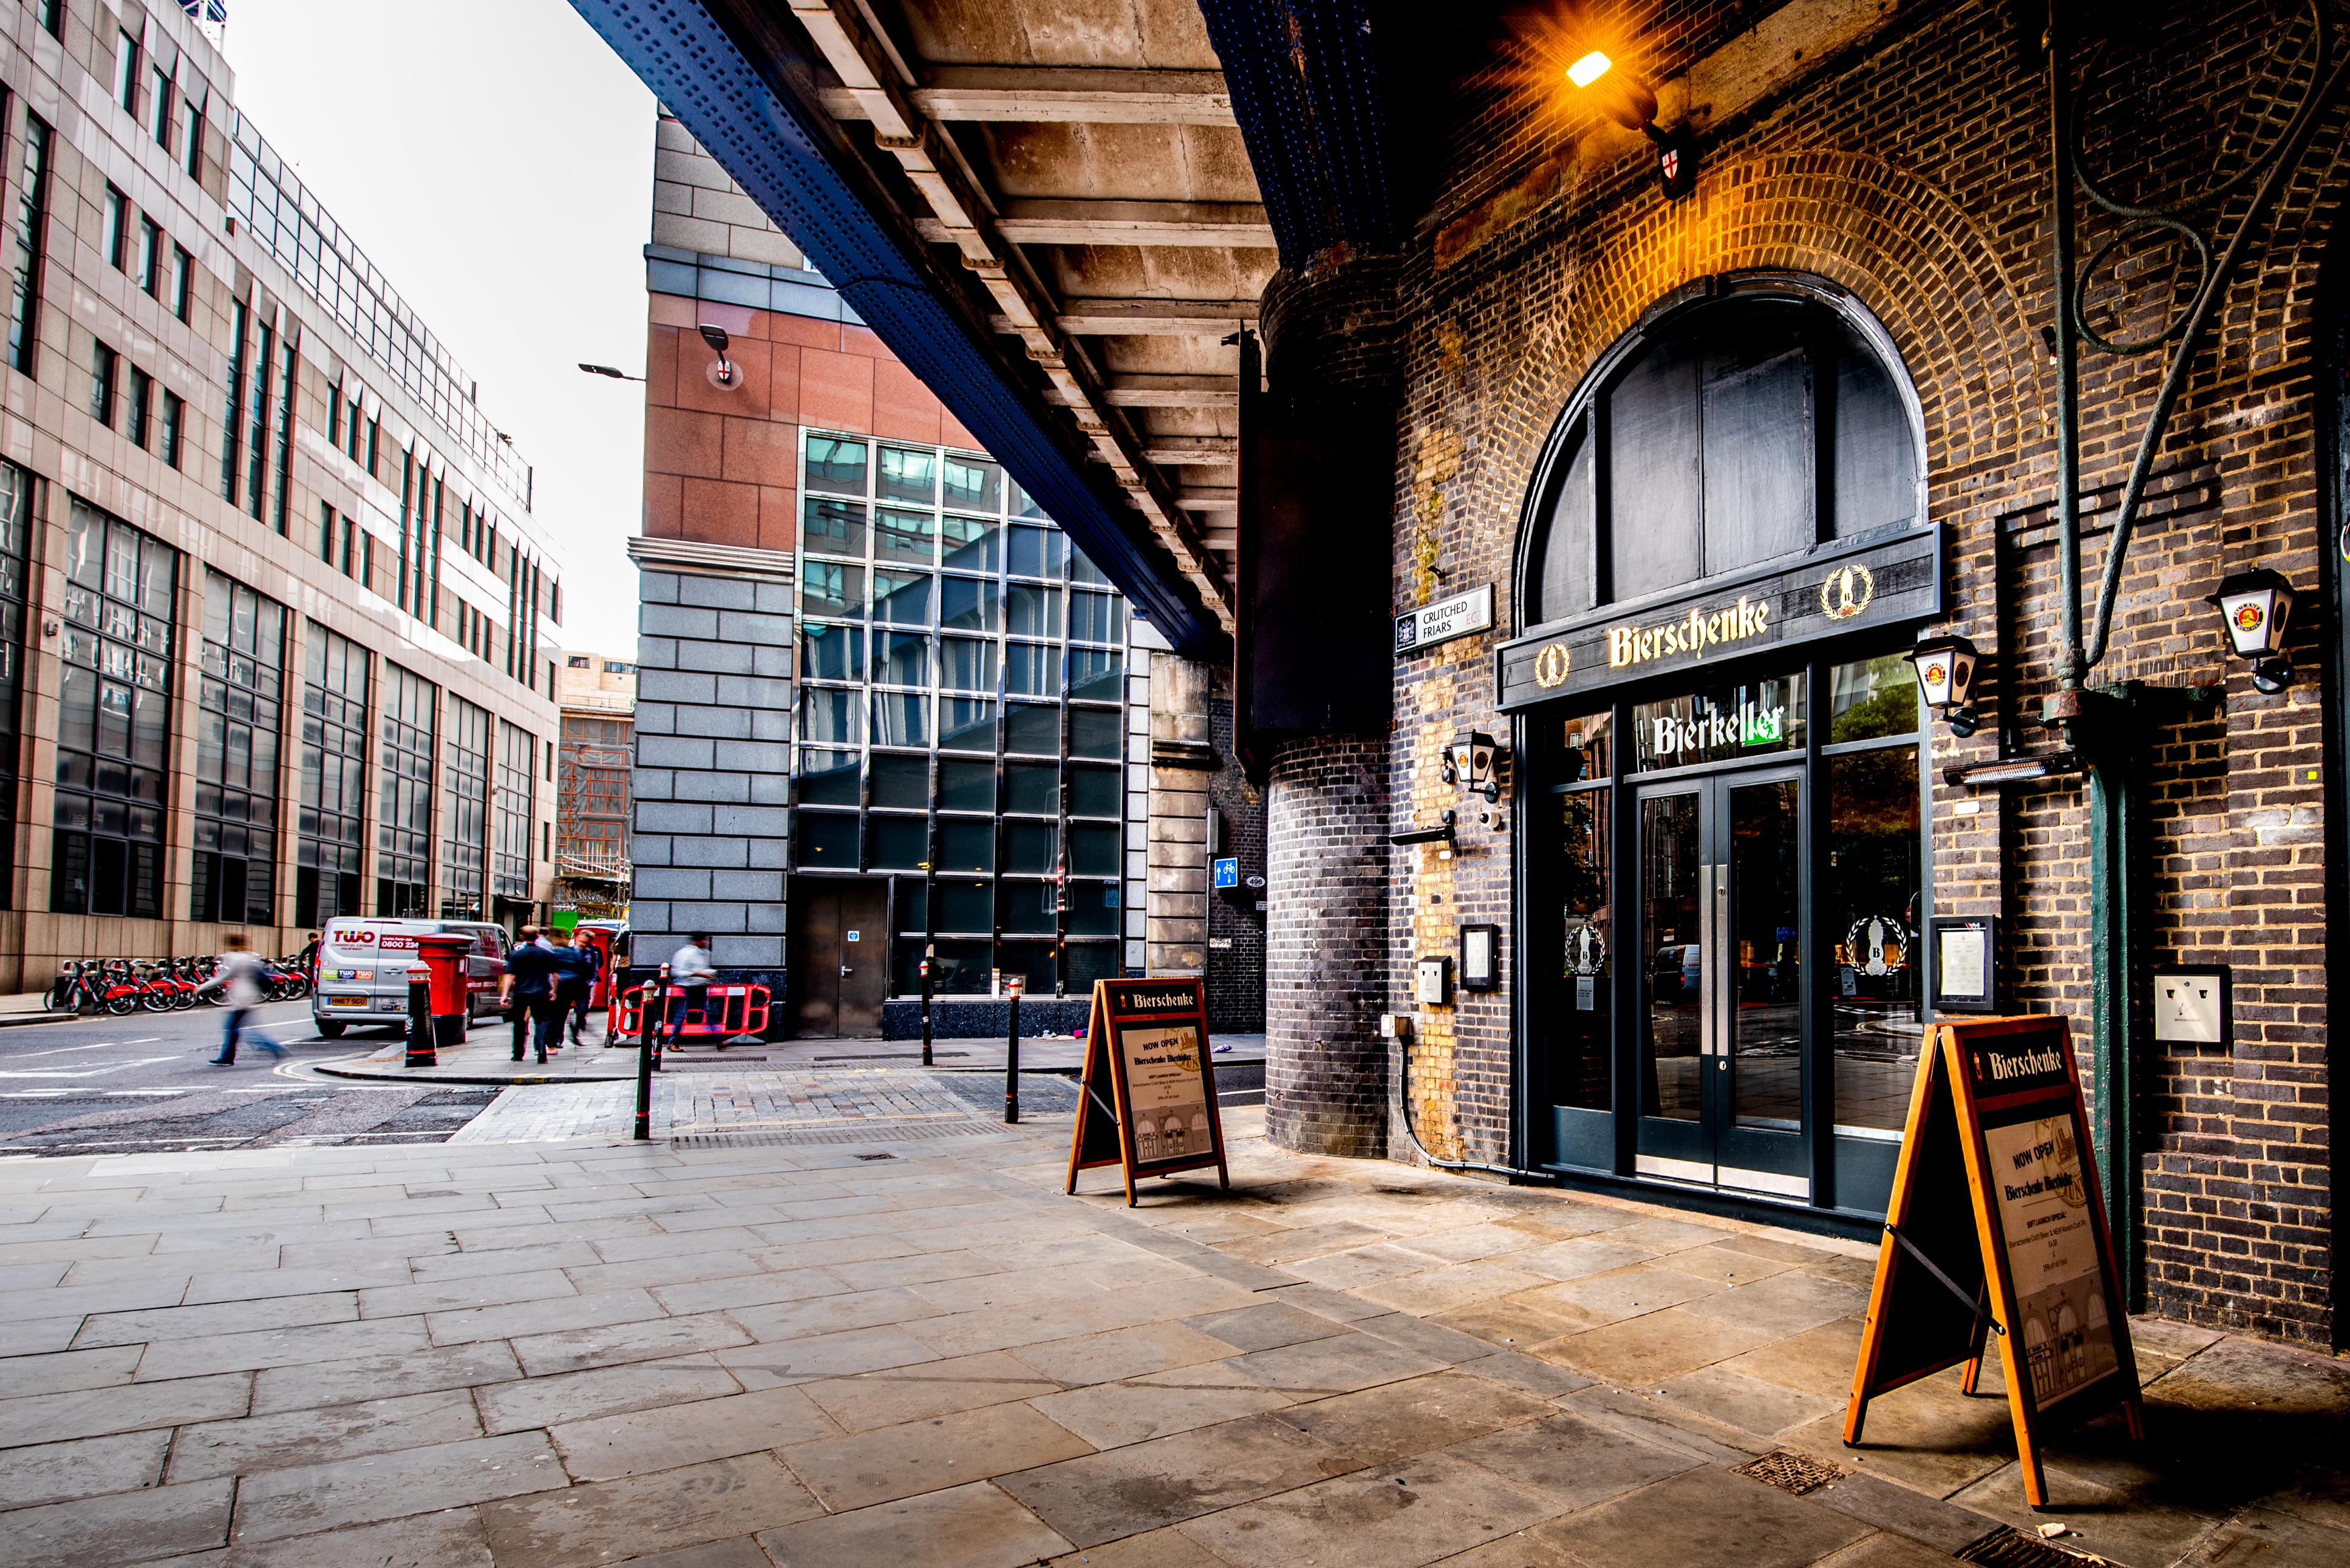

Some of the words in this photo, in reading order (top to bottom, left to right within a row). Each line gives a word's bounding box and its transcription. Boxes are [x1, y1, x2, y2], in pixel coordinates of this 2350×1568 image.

[1844, 592, 1850, 601] B
[1423, 602, 1467, 624] CRUTCHED
[1466, 610, 1482, 625] EC3
[2233, 603, 2262, 617] PAULANER
[1423, 620, 1451, 639] FRIARS
[1608, 595, 1769, 668] Bierschenke
[1651, 701, 1784, 755] Bierkeller
[334, 931, 375, 943] TWO
[1872, 947, 1880, 958] B
[1132, 993, 1193, 1008] Bierschenke
[1143, 1041, 1159, 1051] NOW
[1160, 1037, 1178, 1047] OPEN
[1134, 1056, 1166, 1065] Bierschenke
[1988, 1046, 2062, 1079] Bierschenke
[2012, 1149, 2032, 1170] NOW
[2034, 1140, 2054, 1161] OPEN
[2004, 1179, 2043, 1201] Bierschenke
[2035, 1215, 2051, 1226] LAUNCH
[2008, 1237, 2031, 1249] Bierschenke
[2040, 1231, 2049, 1240] Beer
[2062, 1224, 2073, 1233] Munich
[2048, 1239, 2057, 1248] £4.50
